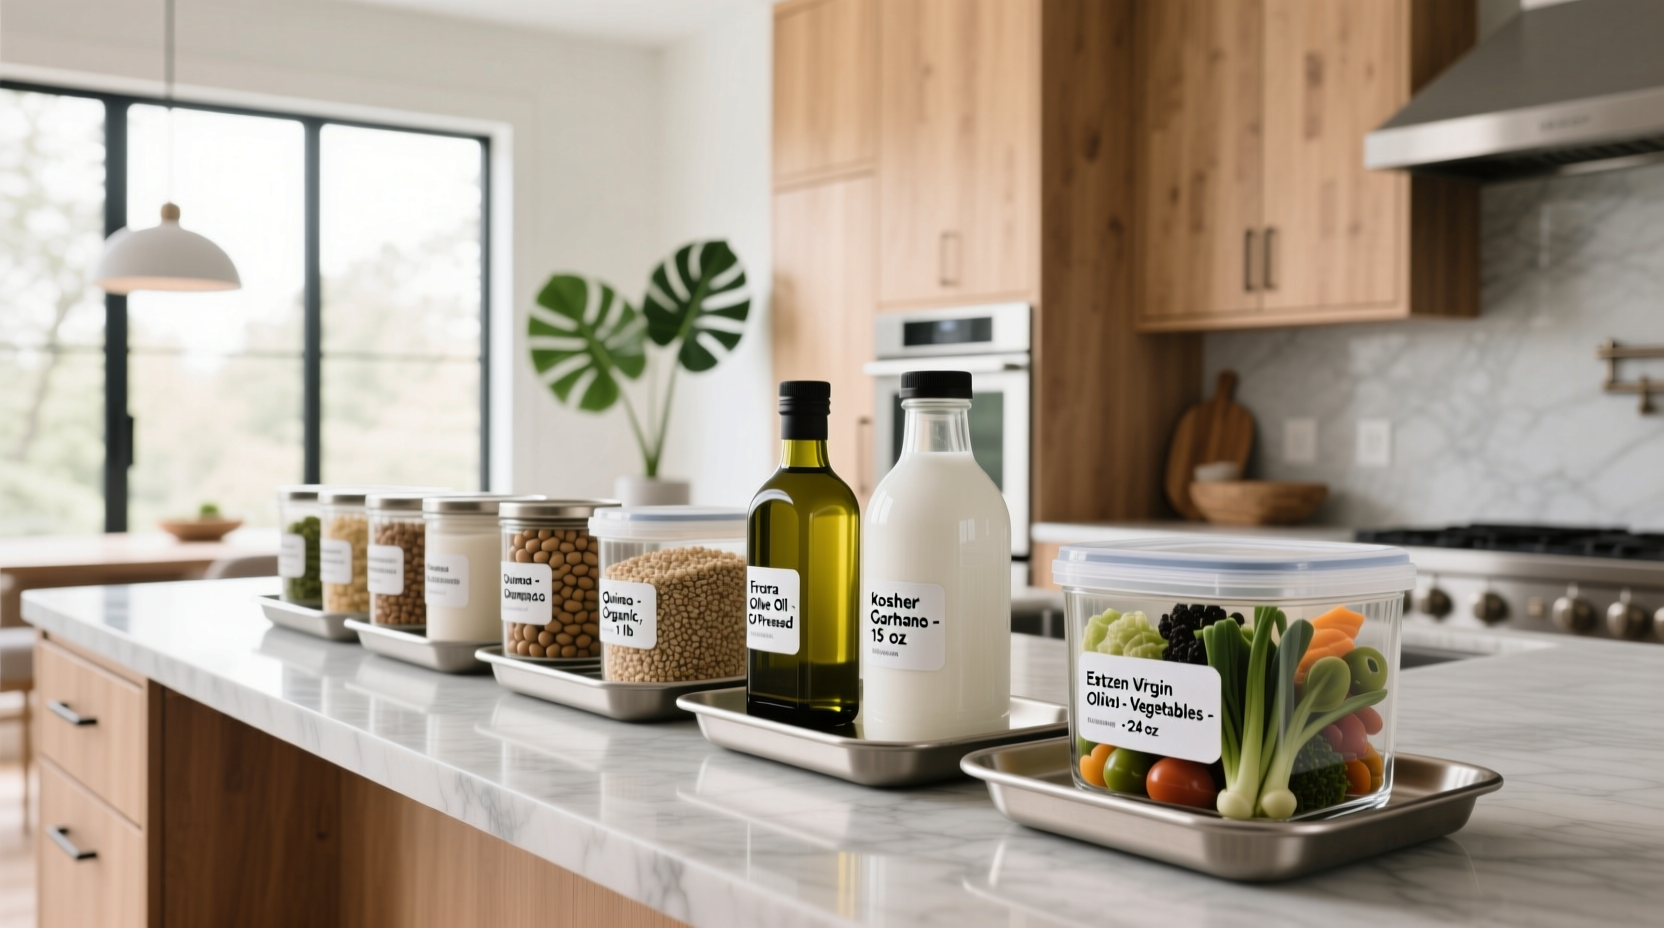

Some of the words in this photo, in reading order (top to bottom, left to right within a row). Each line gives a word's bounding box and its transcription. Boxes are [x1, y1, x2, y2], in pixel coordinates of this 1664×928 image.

[871, 627, 884, 643] 15
[889, 632, 907, 645] oz
[1130, 696, 1204, 721] Vegetables
[1144, 725, 1159, 737] oz
